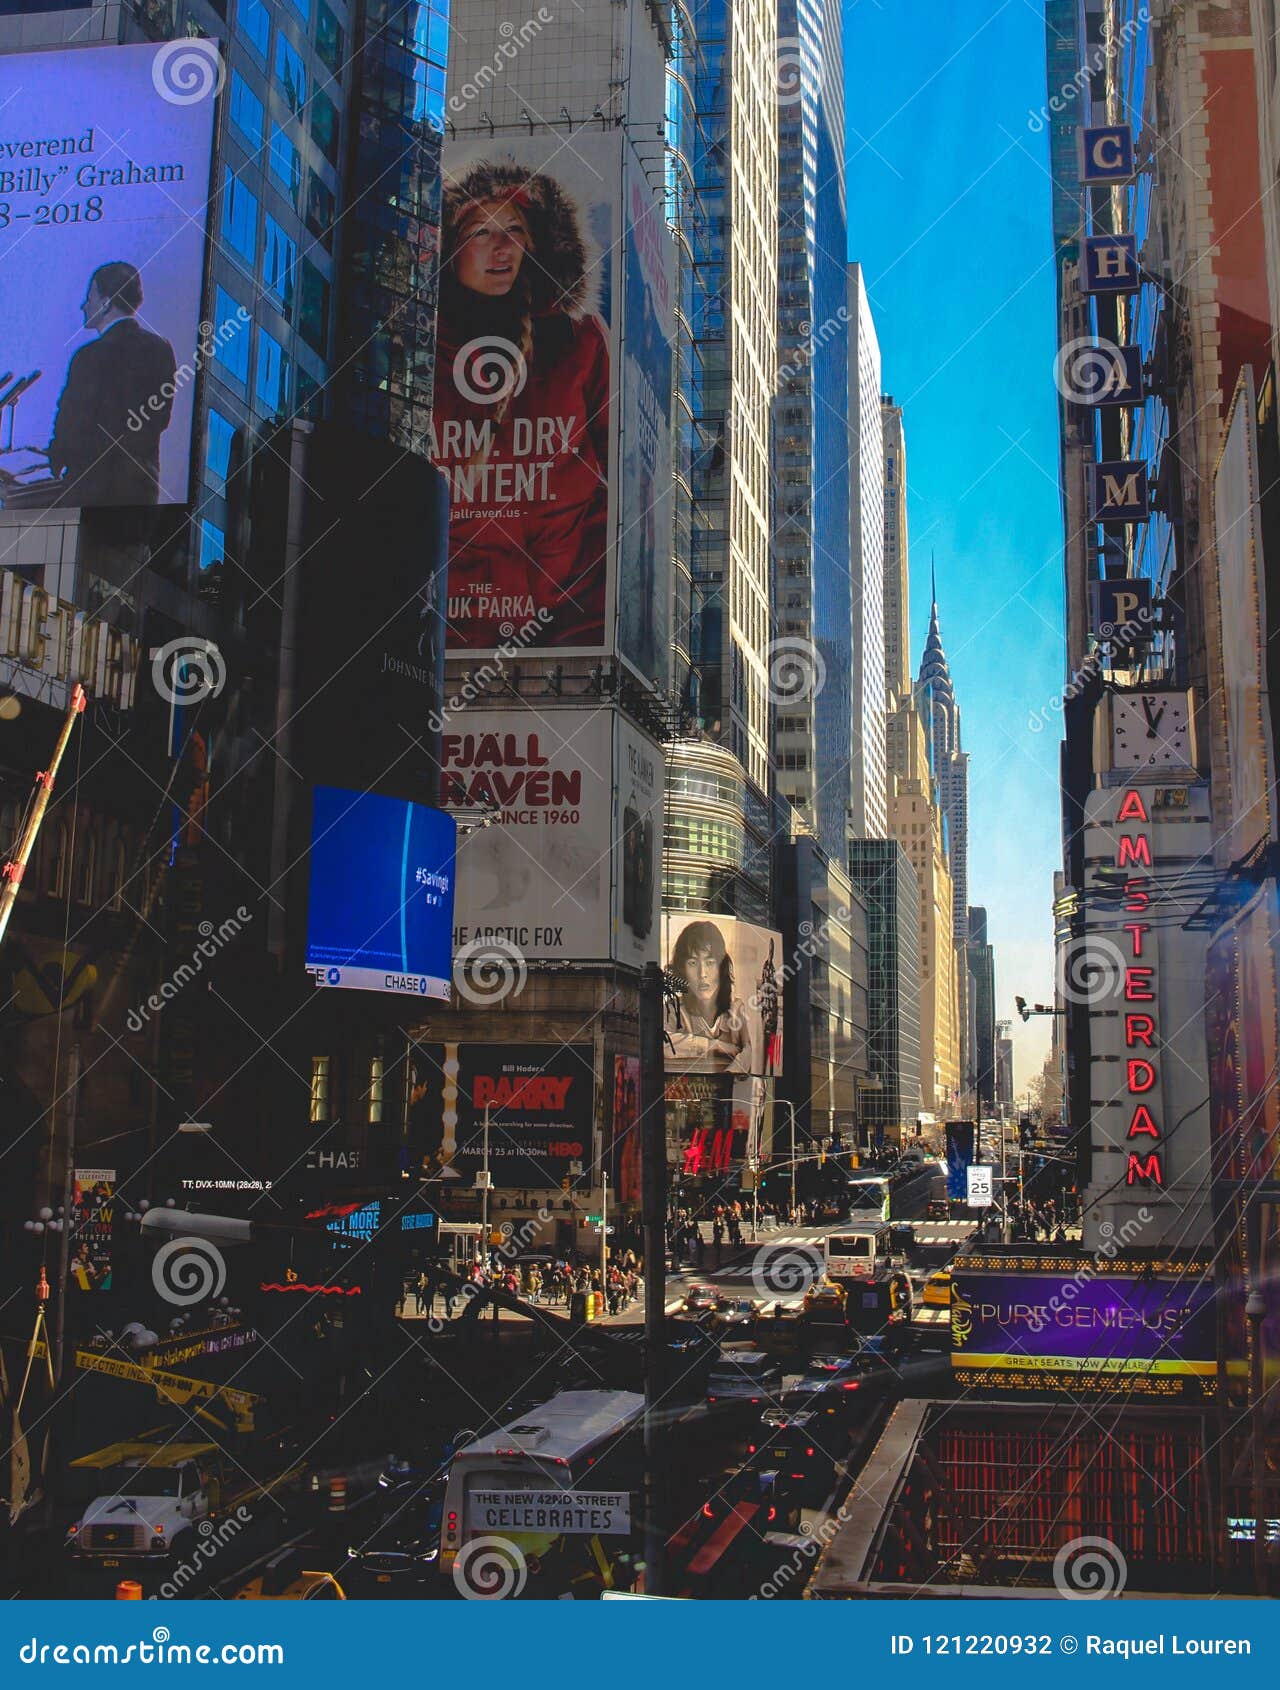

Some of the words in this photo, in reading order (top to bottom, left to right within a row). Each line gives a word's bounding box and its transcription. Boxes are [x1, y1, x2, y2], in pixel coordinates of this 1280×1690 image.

[77, 160, 184, 187] Graham
[430, 419, 500, 459] ARM.
[513, 416, 579, 456] DRY.
[440, 462, 557, 503] NTENT.
[449, 508, 521, 522] jallraven.us
[468, 583, 493, 594] THE
[478, 595, 536, 618] PARKA
[441, 733, 549, 768] FJÄLL
[439, 770, 582, 807] RÄVEN
[543, 810, 580, 825] 1960
[451, 927, 467, 945] HE
[473, 927, 529, 946] ARCTIC
[535, 927, 563, 946] FOX
[385, 974, 419, 991] CHASE
[1116, 789, 1166, 1187] AMSTERDAM
[502, 1064, 515, 1073] Bill
[472, 1074, 573, 1111] BARRY
[495, 1148, 505, 1156] 25
[548, 1141, 584, 1157] HBO
[306, 1151, 360, 1169] CHAS
[971, 1183, 989, 1193] 25
[349, 1211, 380, 1229] MORE
[1040, 1359, 1073, 1368] SEATS
[1077, 1360, 1099, 1369] NOW
[476, 1493, 501, 1505] THE
[504, 1494, 535, 1505] NEW
[537, 1494, 572, 1505] 42ND
[576, 1495, 622, 1506] STREET
[486, 1508, 613, 1529] CELEBRATES
